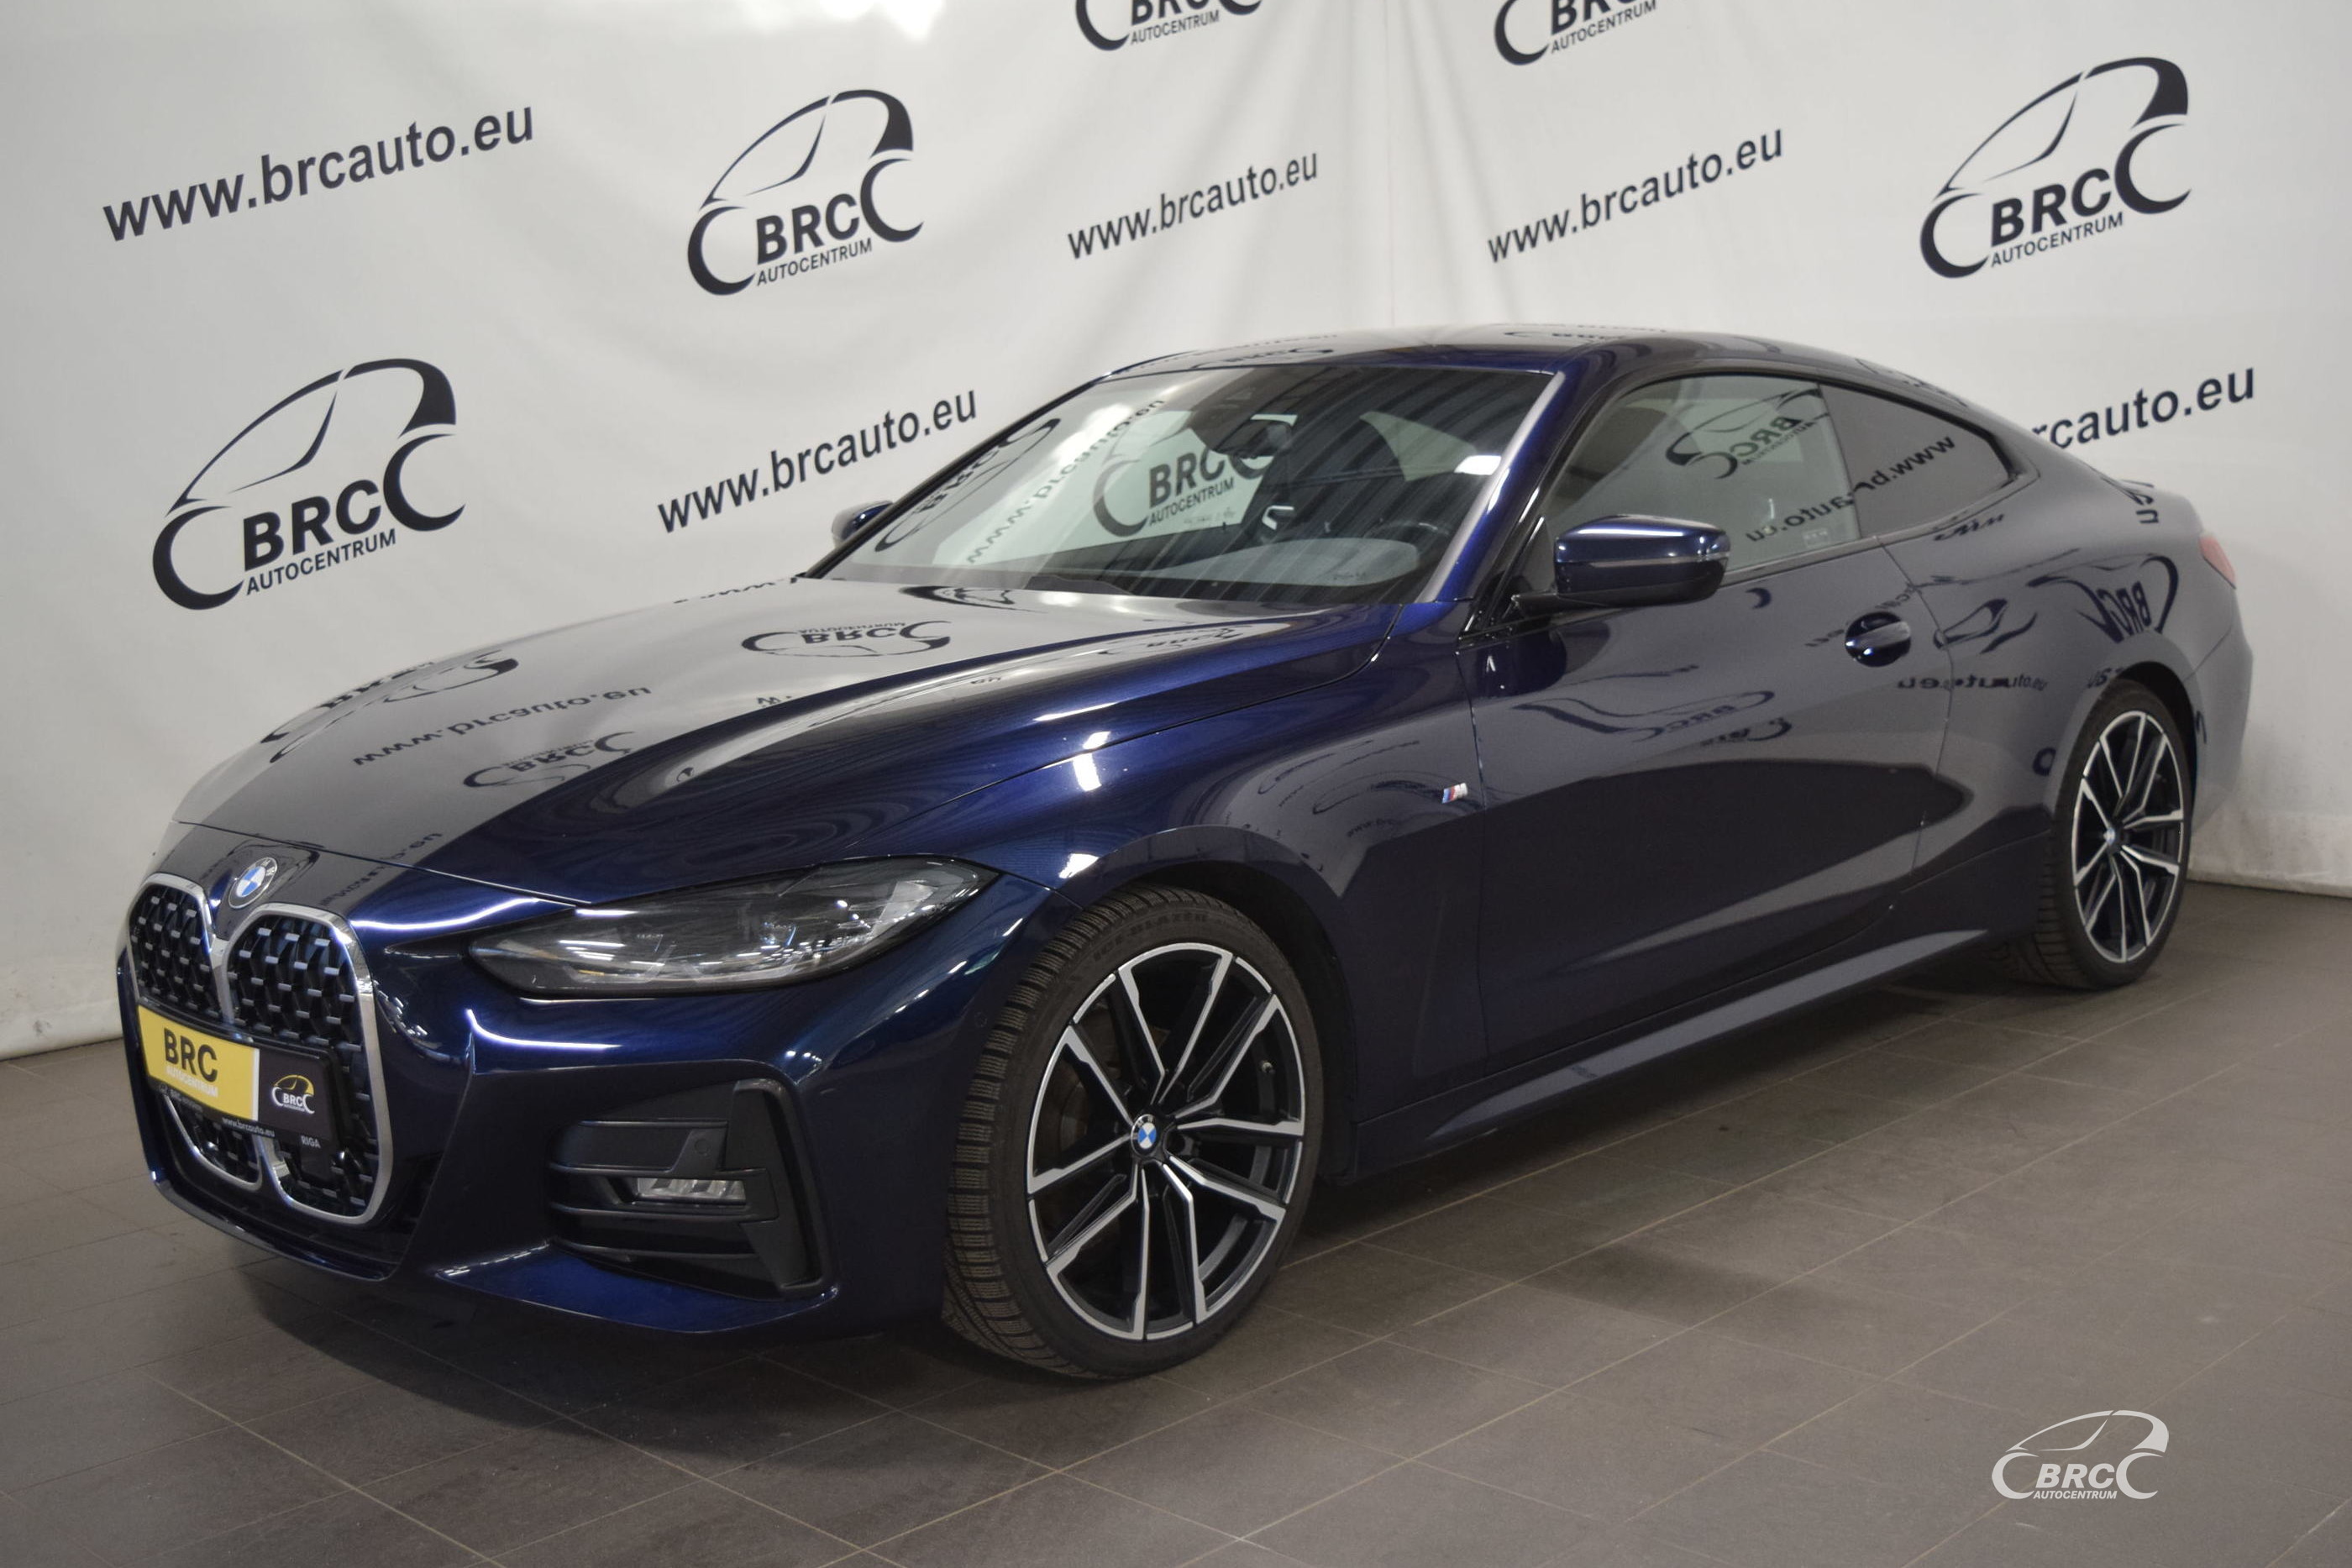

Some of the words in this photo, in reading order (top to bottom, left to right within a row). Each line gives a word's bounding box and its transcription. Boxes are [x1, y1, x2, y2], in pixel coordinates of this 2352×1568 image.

[1131, 9, 1220, 45] AUTOCENTRUM
[1551, 0, 1657, 53] AUTOCENTRUM
[102, 107, 533, 242] www.brcauto.eu
[1067, 153, 1318, 260] www.brcauto.eu
[1488, 128, 1783, 263] www.brcauto.eu
[1990, 168, 2113, 247] BRC
[755, 193, 860, 265] BRC
[755, 237, 873, 287] AUTOCENTRUM
[1991, 211, 2124, 268] AUTOCENTRUM
[657, 390, 978, 534] www.brcauto.eu
[1149, 443, 1226, 509] BRC
[243, 479, 382, 572] BRC
[1149, 476, 1235, 527] AUTOCENTRUM
[245, 528, 397, 597] AUTOCENTRUM
[163, 1027, 218, 1083] BRC
[283, 1093, 303, 1107] BRC
[301, 1135, 321, 1149] RIGA
